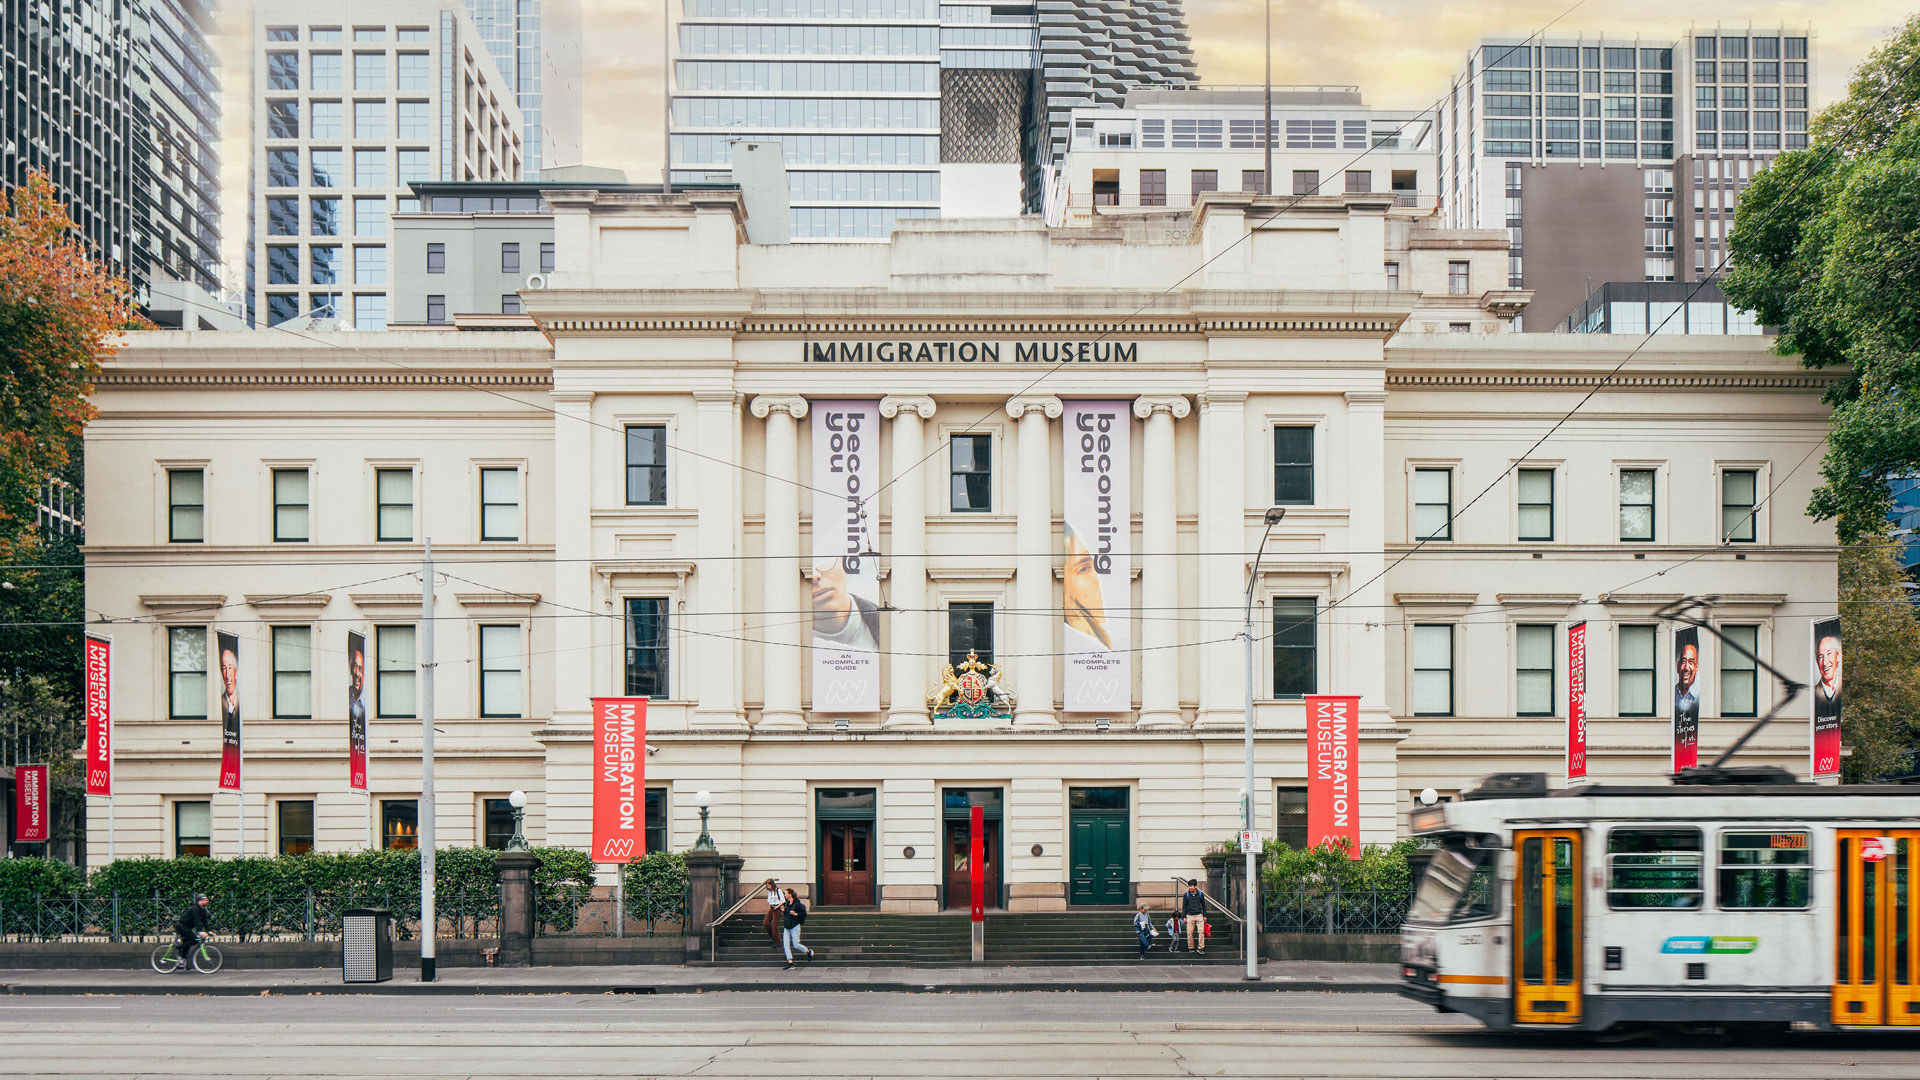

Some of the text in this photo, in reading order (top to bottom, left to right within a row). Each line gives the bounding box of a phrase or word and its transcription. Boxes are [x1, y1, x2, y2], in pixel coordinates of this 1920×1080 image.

[1165, 230, 1191, 240] POR
[803, 342, 1138, 362] IMMIGRATION MUSEUM
[825, 412, 843, 473] you
[1076, 412, 1094, 473] you
[842, 413, 867, 574] becoming
[1093, 413, 1118, 574] becoming
[89, 645, 99, 717] MUSEUM
[98, 646, 107, 762] IMMIGRATION
[604, 704, 619, 782] MUSEUM
[620, 704, 635, 830] IMMIGRATION
[1317, 702, 1332, 780] MUSEUM
[1333, 702, 1348, 827] IMMIGRATION
[24, 770, 32, 806] MUSEUM
[31, 770, 39, 826] IMMIGRATION
